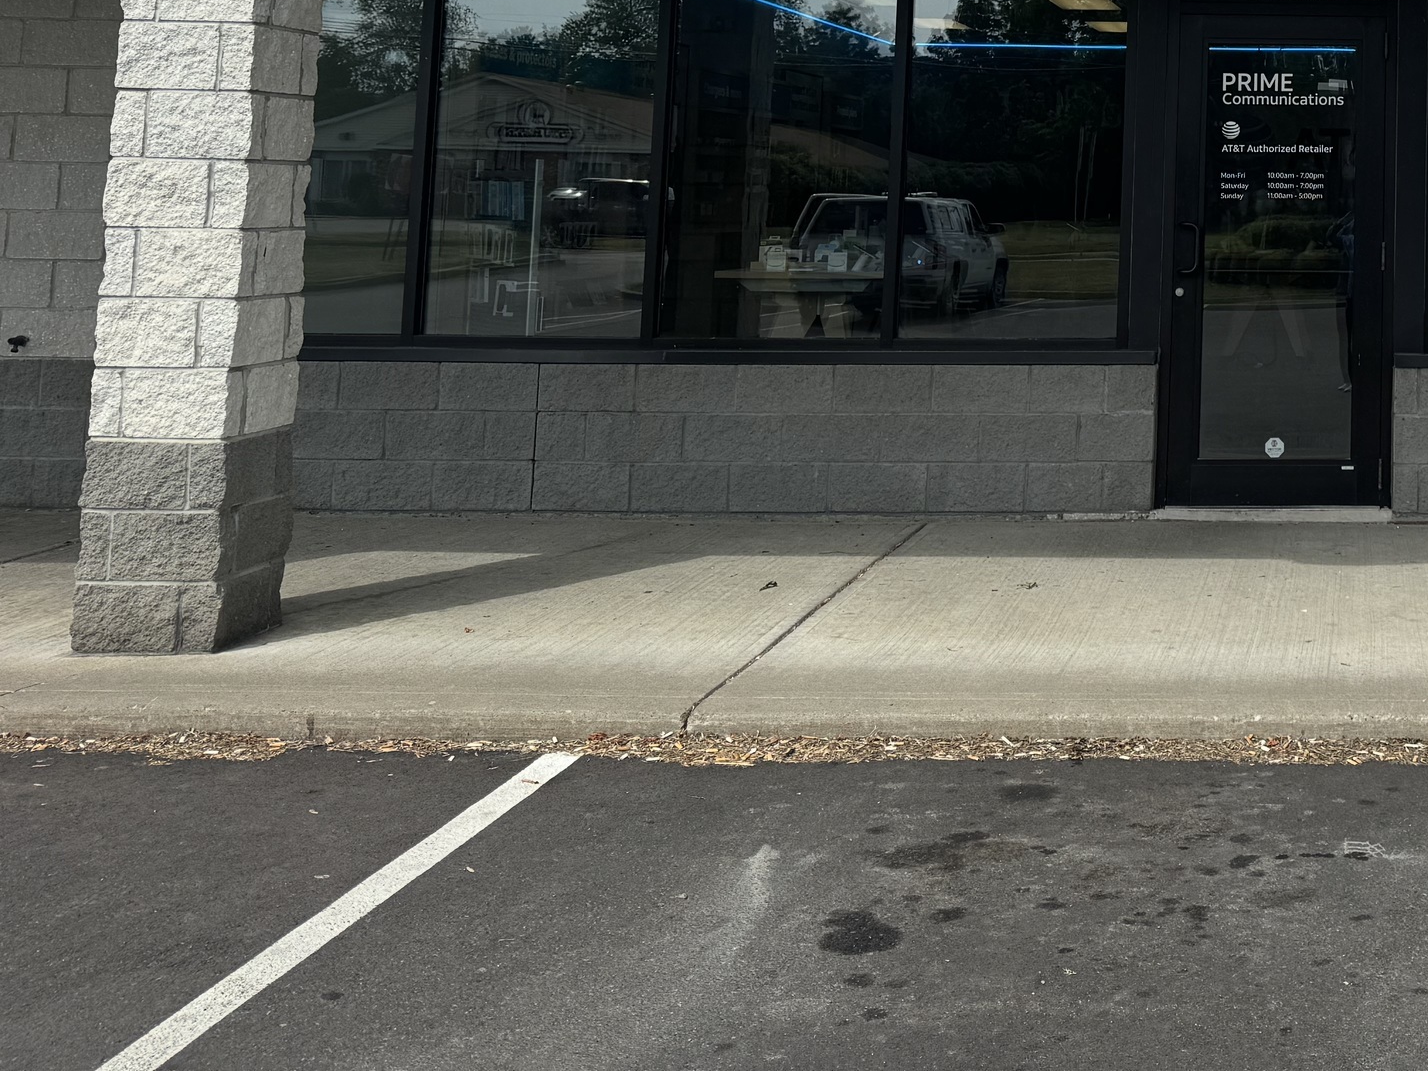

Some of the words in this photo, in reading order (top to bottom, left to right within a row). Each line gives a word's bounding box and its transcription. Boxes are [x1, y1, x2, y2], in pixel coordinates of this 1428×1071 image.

[1222, 73, 1294, 92] PRIME
[1222, 92, 1344, 106] Communications
[1221, 144, 1246, 153] AT&T
[1246, 144, 1297, 153] Authorized
[1298, 144, 1334, 154] Retailer
[1220, 182, 1250, 191] Saturday
[1220, 192, 1244, 201] Sunday
